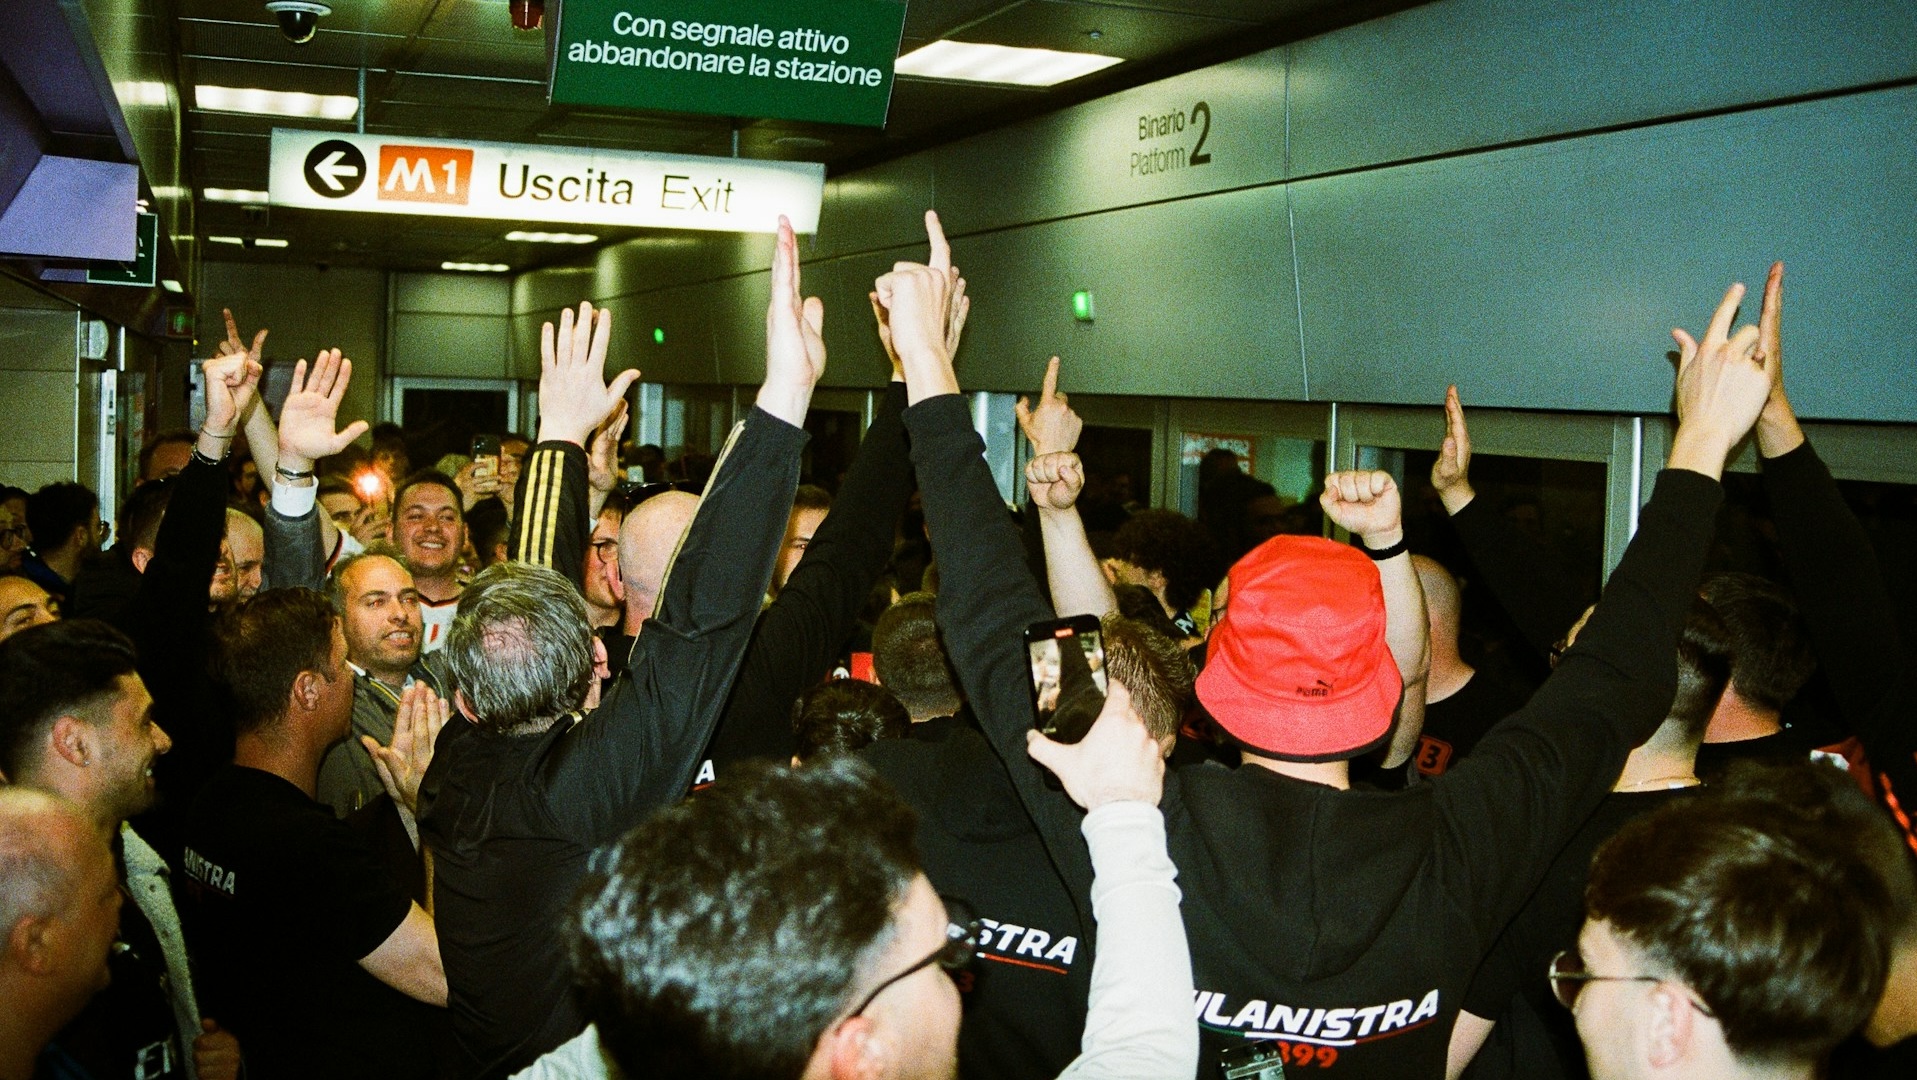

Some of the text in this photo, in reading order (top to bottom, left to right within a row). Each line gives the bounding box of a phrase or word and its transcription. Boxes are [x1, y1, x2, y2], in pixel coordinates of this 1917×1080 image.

[613, 11, 850, 55] Con segnale attivo
[568, 40, 883, 88] abbandonare la stazione
[1138, 107, 1186, 141] Binario
[1189, 101, 1212, 167] 2
[383, 156, 735, 214] M1 Uscita Exit
[1129, 147, 1186, 178] Platform
